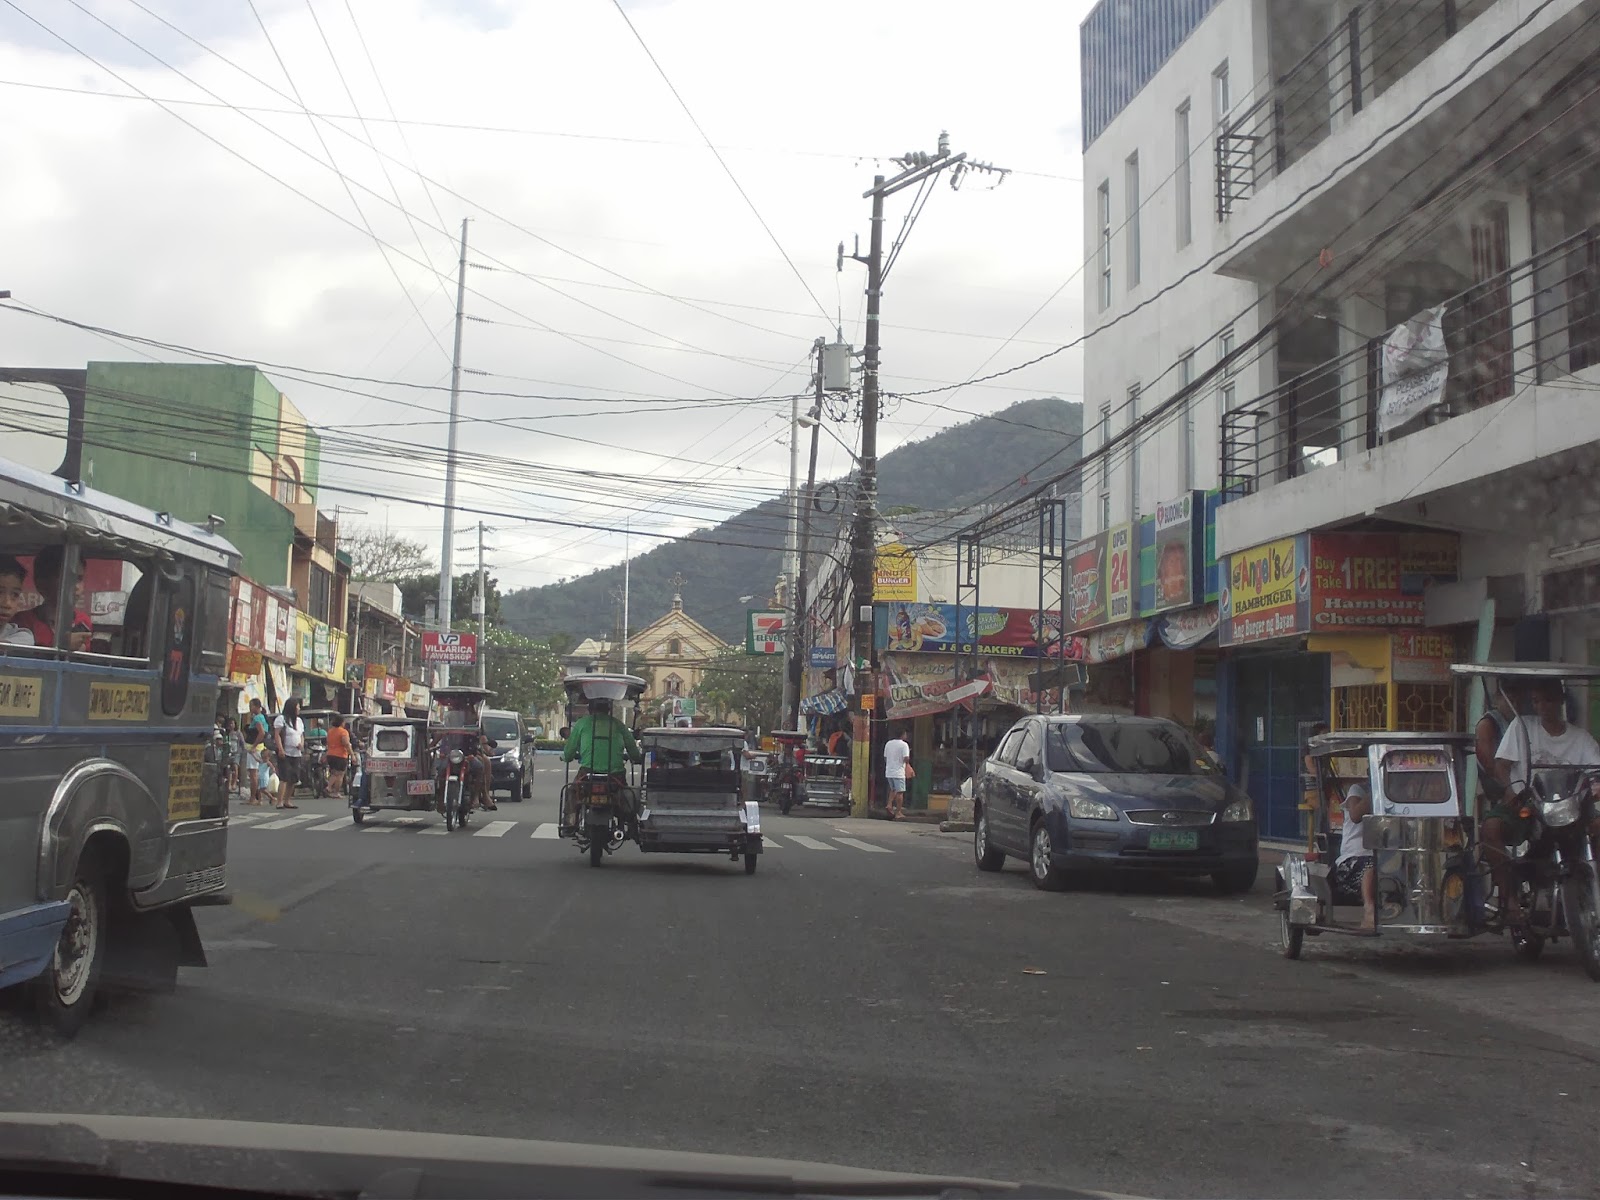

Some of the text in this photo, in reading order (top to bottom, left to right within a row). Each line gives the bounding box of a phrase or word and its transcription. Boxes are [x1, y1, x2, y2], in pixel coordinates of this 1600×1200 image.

[1112, 529, 1128, 549] OPEN
[1111, 550, 1128, 594] 24
[1315, 556, 1335, 573] Buy
[1315, 574, 1342, 590] Take
[1353, 557, 1398, 590] FREE
[1235, 589, 1293, 614] HAMBURGER
[424, 644, 473, 654] VILLARICA
[425, 652, 472, 660] PAWNSHOP
[977, 645, 1024, 655] BAKERY
